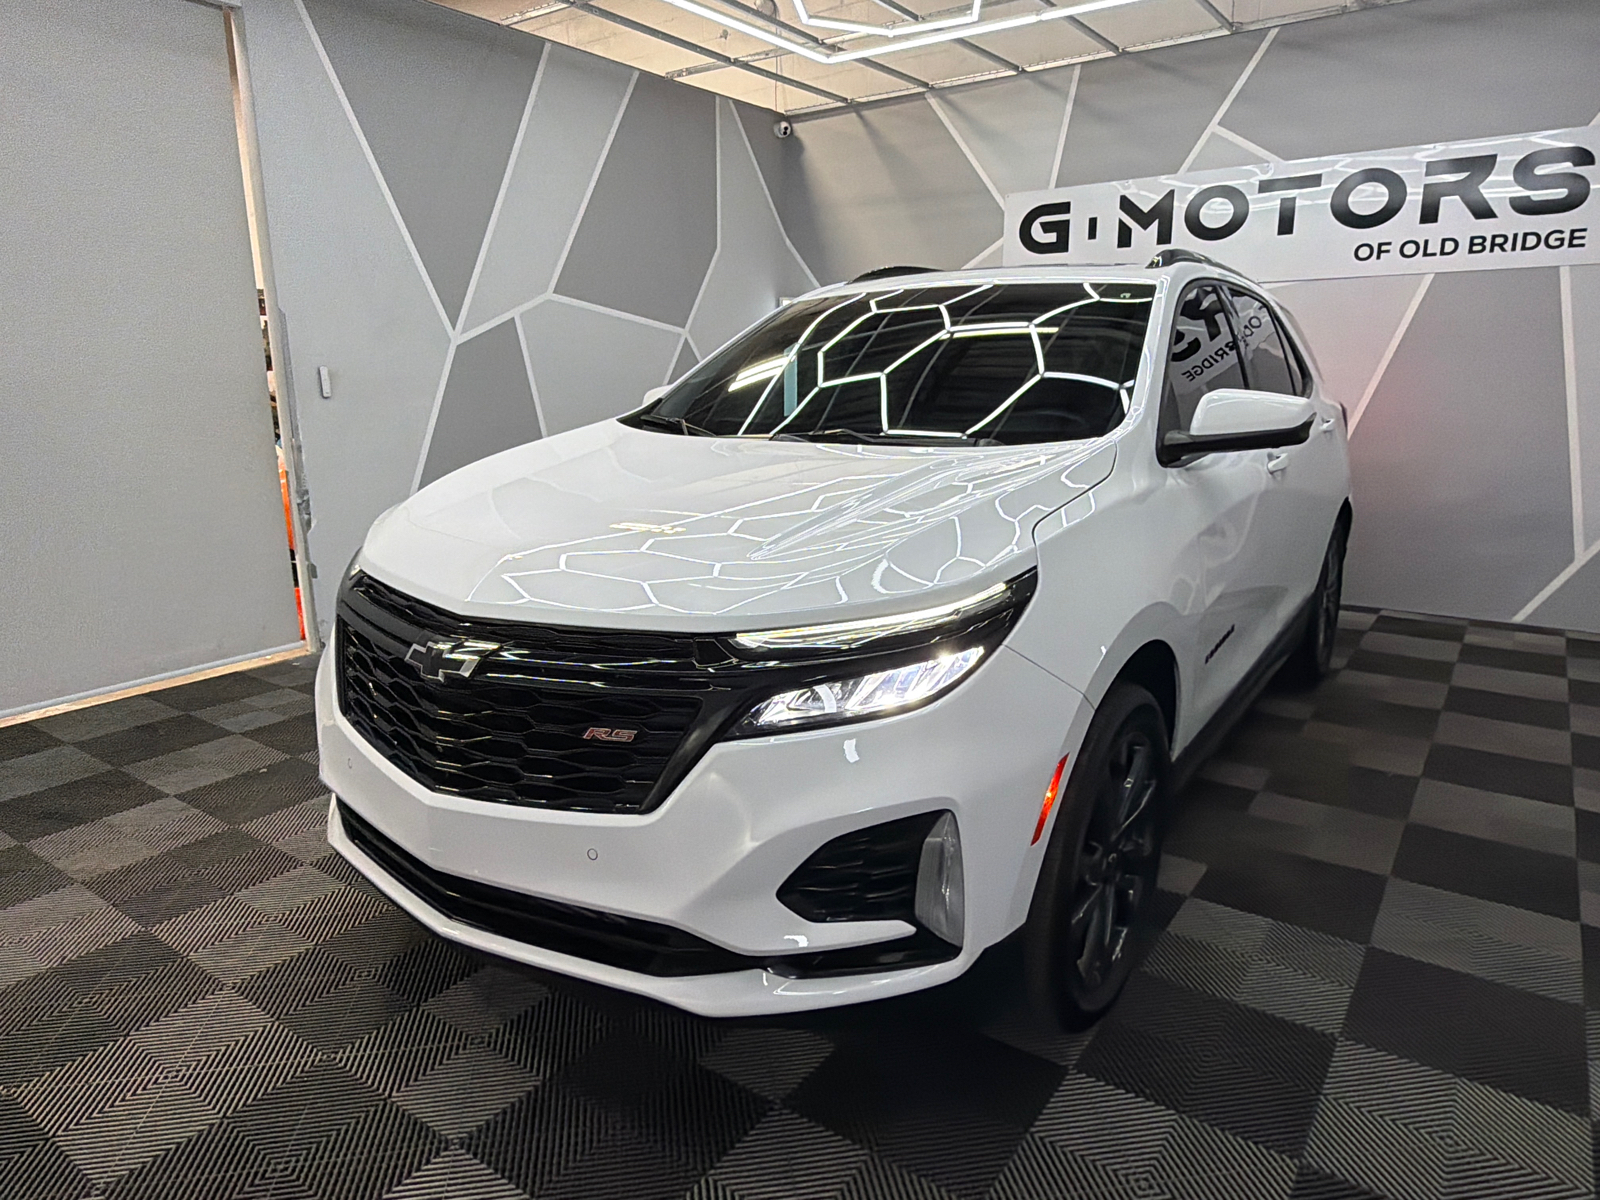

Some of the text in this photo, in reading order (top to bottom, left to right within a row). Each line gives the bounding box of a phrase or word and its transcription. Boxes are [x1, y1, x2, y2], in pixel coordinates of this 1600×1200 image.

[1353, 228, 1588, 262] OF OLD BRIDGE
[583, 727, 638, 742] RS
